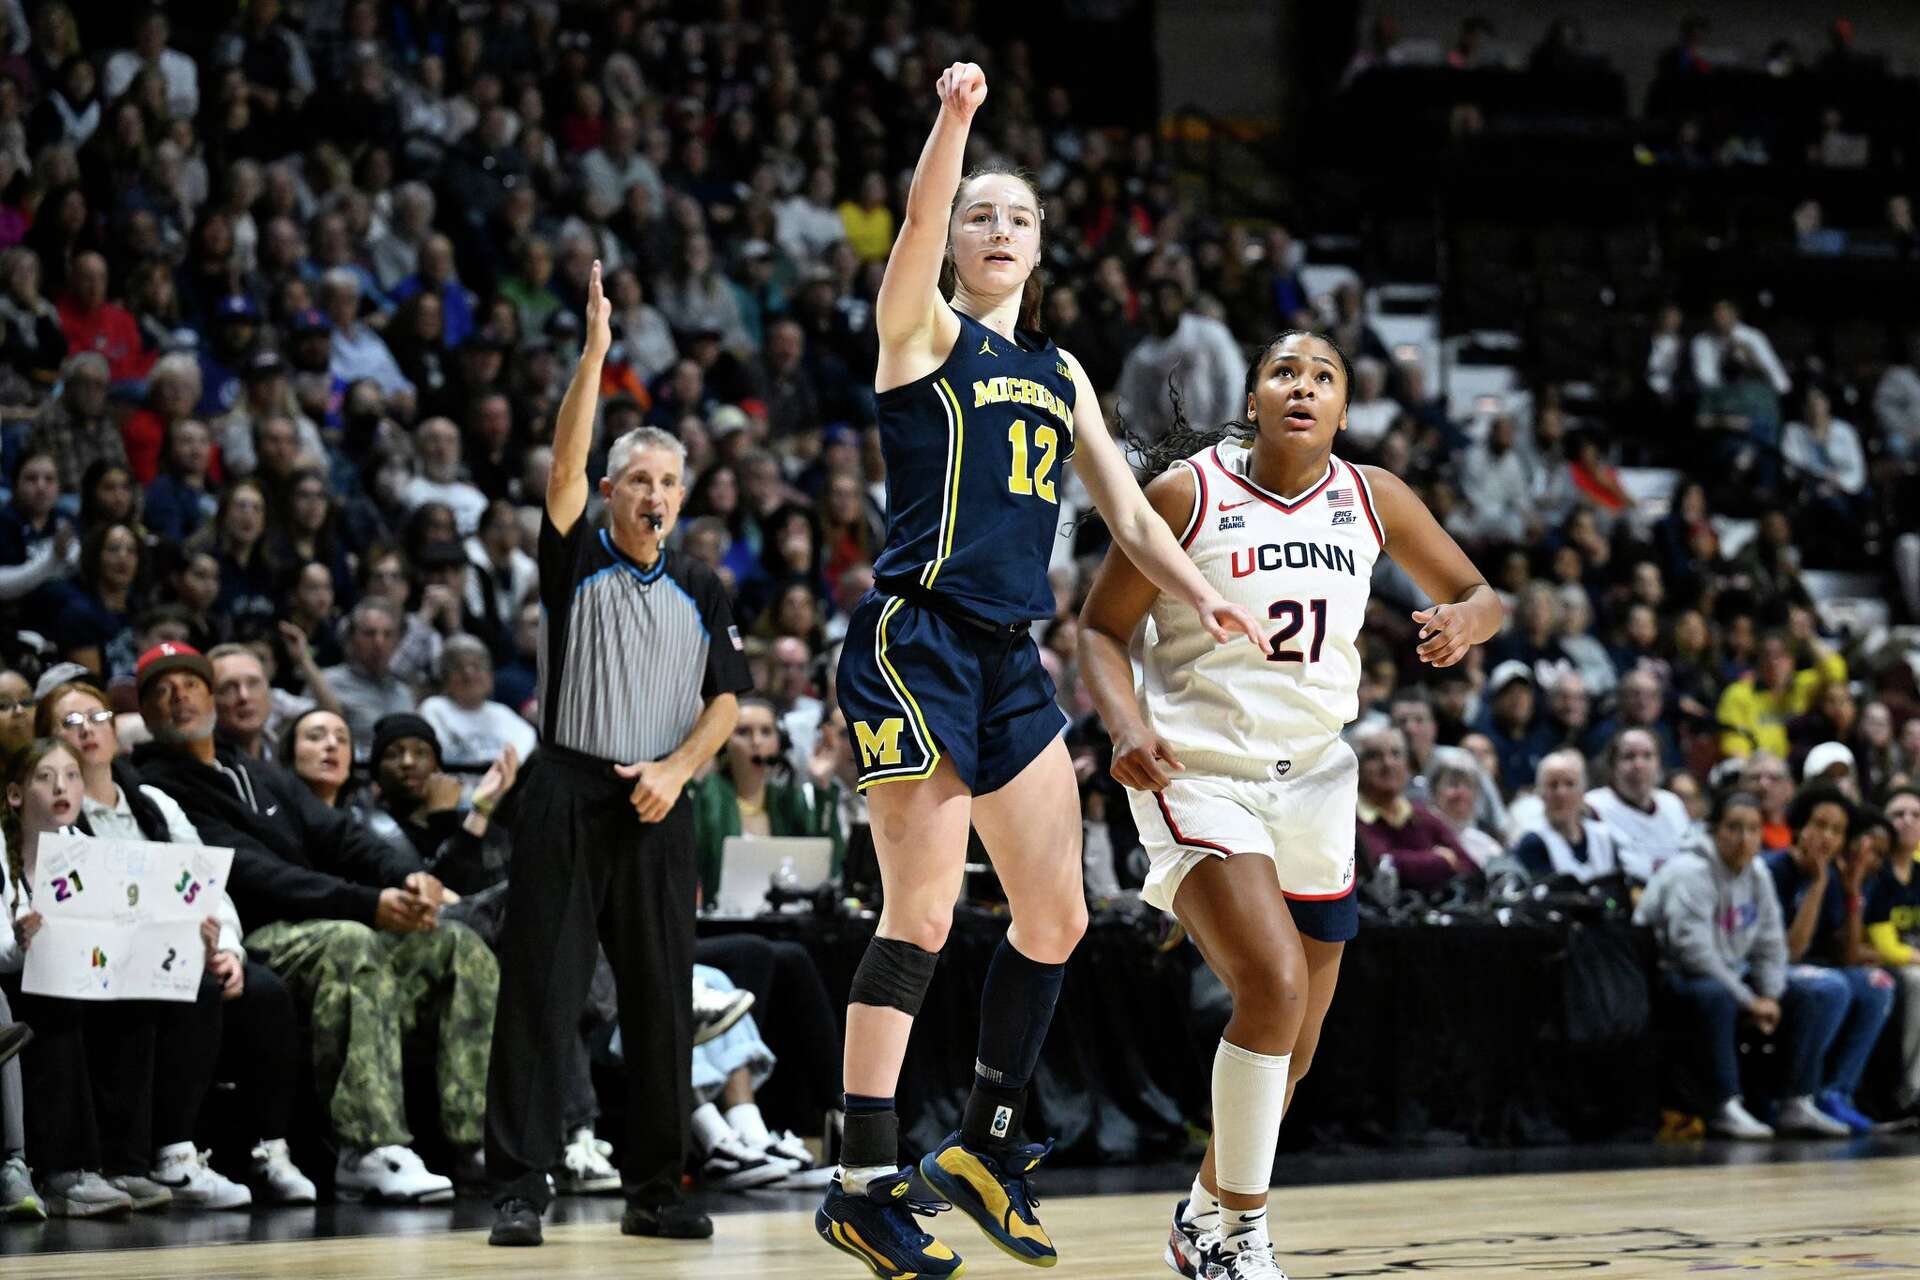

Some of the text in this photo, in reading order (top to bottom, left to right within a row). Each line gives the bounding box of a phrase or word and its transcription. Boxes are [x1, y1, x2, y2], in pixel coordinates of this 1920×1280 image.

[1008, 419, 1058, 505] 12
[1218, 521, 1246, 532] CHANGE
[1220, 516, 1230, 524] BE
[1231, 541, 1356, 578] UCONN
[1266, 598, 1328, 664] 21
[853, 718, 904, 768] M
[51, 869, 84, 902] 21
[127, 883, 140, 907] 9
[161, 947, 177, 972] 2
